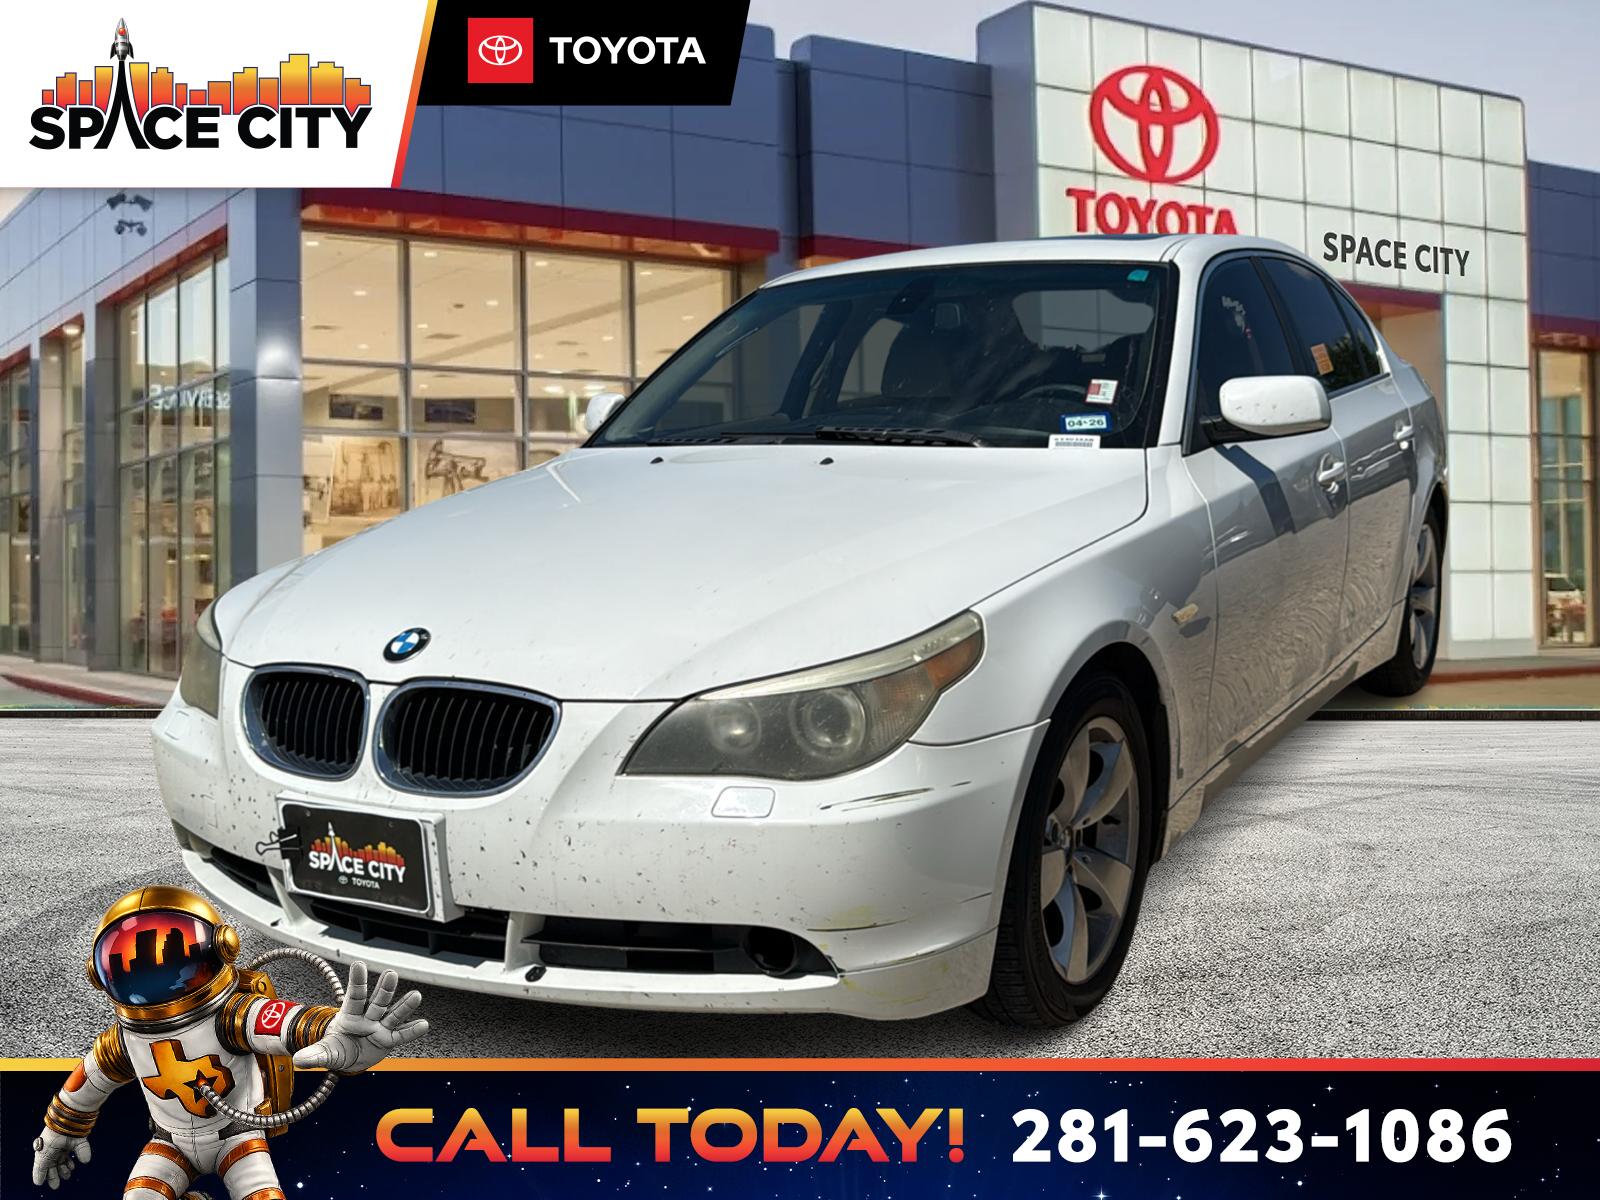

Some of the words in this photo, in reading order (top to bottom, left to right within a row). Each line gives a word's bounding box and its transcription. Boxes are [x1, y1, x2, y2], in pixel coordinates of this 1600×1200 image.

[1066, 187, 1238, 235] TOYOTA
[1323, 232, 1407, 270] SPACE
[1414, 244, 1470, 277] CITY
[309, 851, 365, 875] SPACE
[368, 860, 406, 883] CITY
[352, 877, 380, 889] TOYOTA
